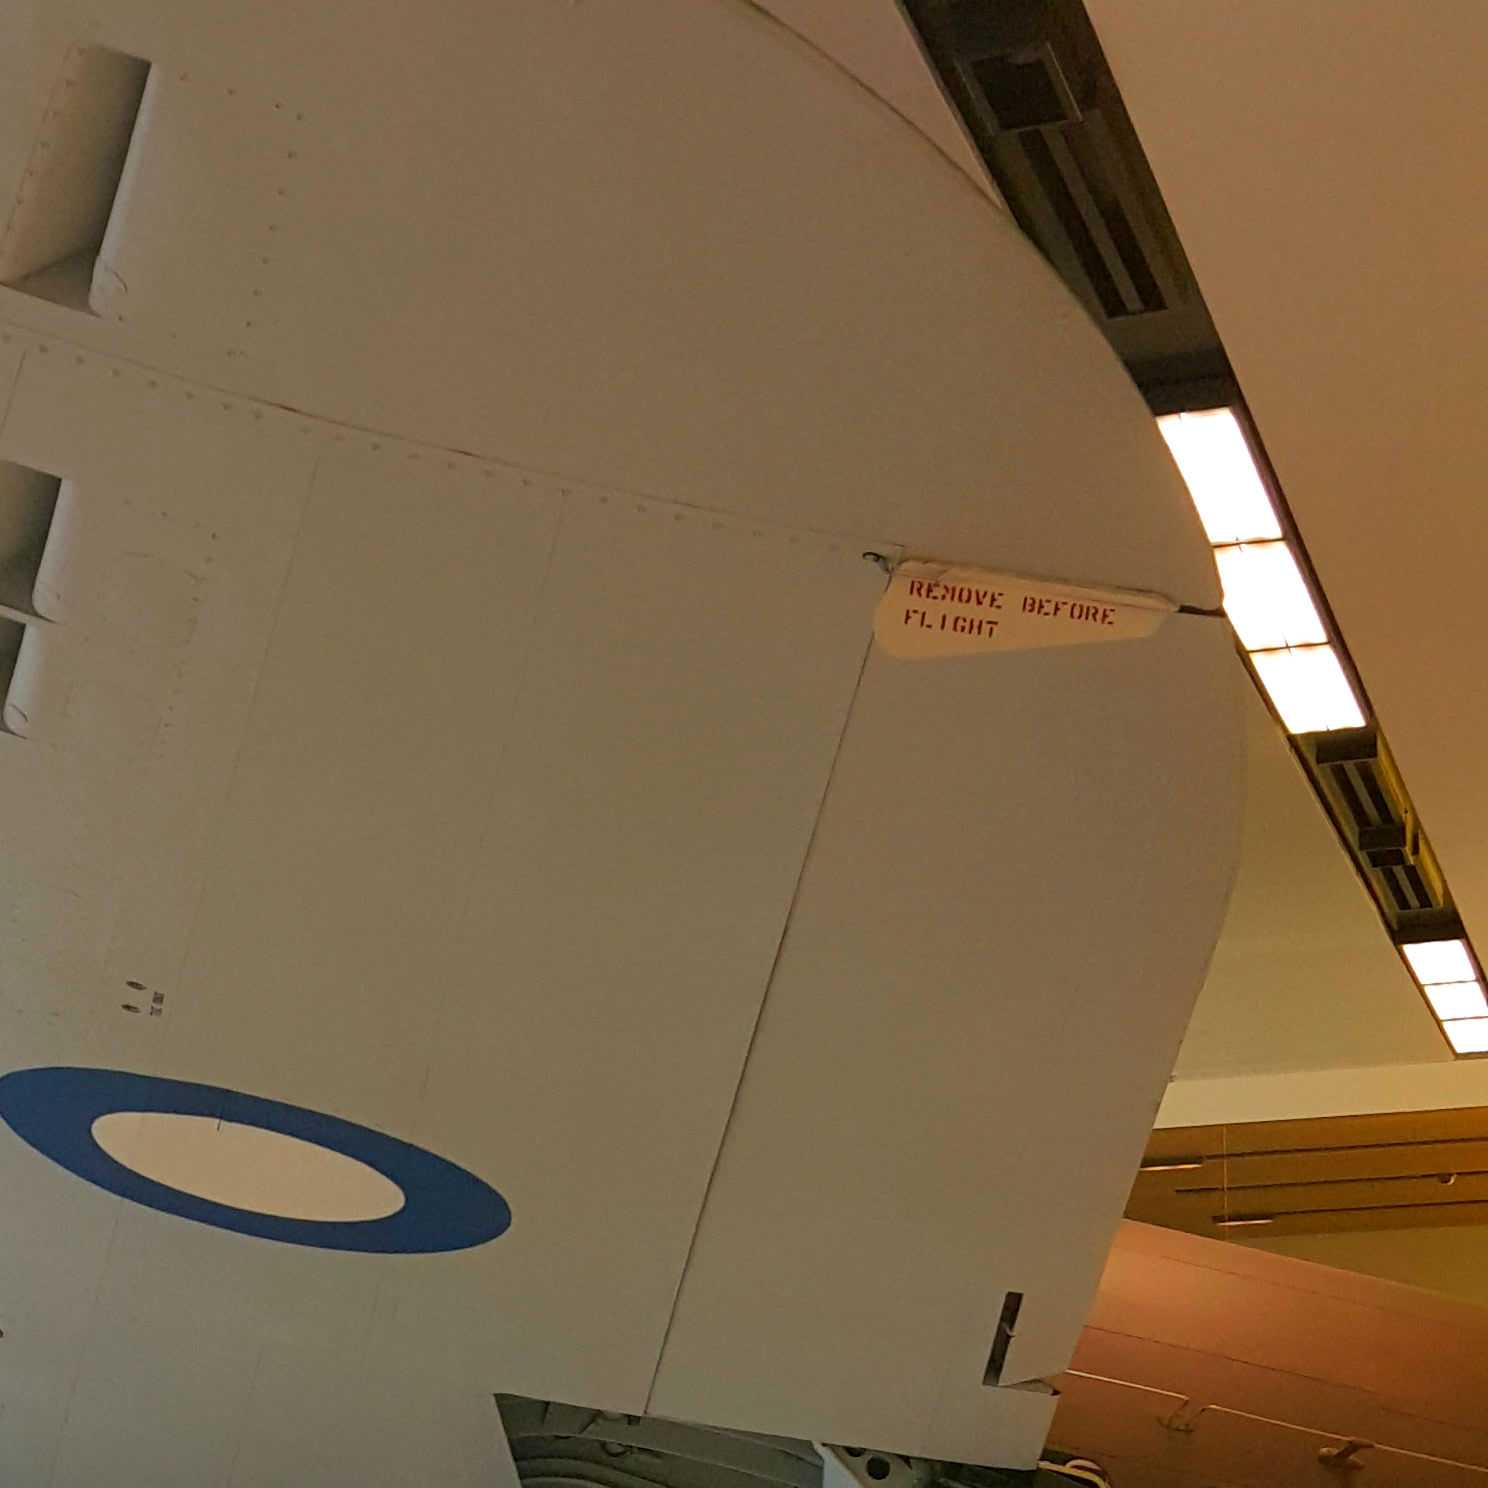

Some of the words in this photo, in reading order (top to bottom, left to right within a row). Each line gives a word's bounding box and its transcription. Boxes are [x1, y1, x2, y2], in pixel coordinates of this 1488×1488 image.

[909, 579, 1005, 610] REMOVE
[1021, 595, 1117, 626] BEFORE
[903, 608, 1000, 639] FLIGHT
